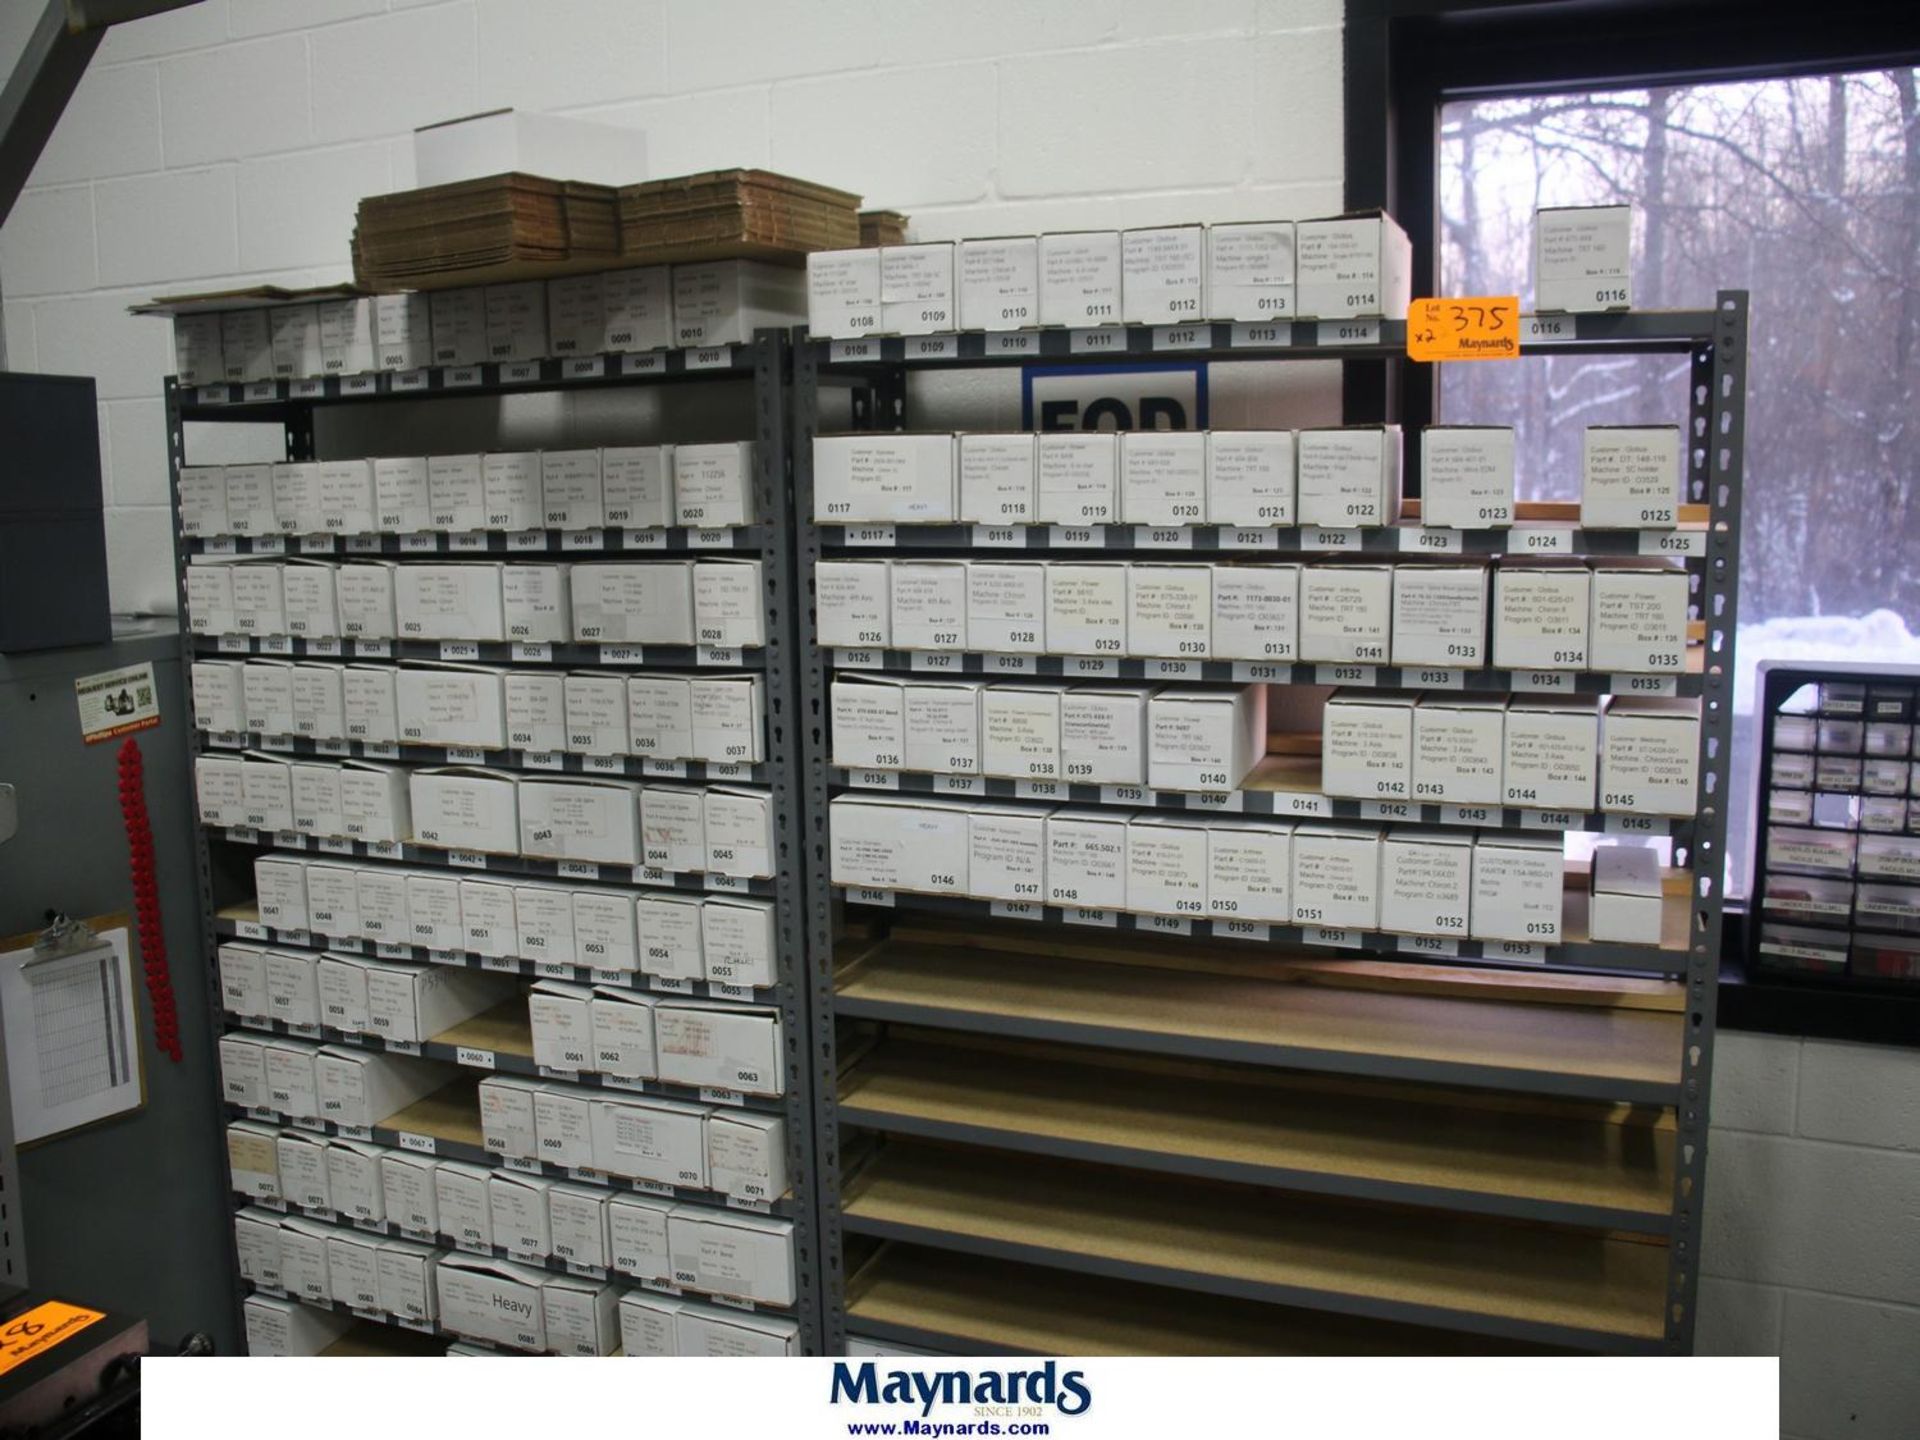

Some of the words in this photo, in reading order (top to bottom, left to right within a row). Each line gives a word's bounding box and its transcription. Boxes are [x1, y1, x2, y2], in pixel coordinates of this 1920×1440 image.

[1347, 294, 1374, 305] 0114
[1596, 290, 1625, 302] 0116
[1170, 300, 1195, 311] 0112
[1259, 299, 1285, 309] 0113
[1002, 307, 1027, 318] 0110
[1087, 305, 1111, 316] 0111
[922, 311, 945, 321] 0109
[1450, 306, 1508, 331] 375
[851, 317, 874, 327] 0108
[681, 328, 702, 338] 0010
[1340, 327, 1367, 338] 0114
[1532, 323, 1560, 334] 0116
[612, 334, 631, 344] 0009
[1087, 335, 1111, 345] 0111
[1169, 332, 1194, 343] 0112
[1250, 330, 1276, 341] 0113
[921, 342, 944, 353] 0109
[1002, 337, 1026, 348] 0110
[1459, 337, 1514, 352] Maynards
[699, 352, 719, 362] 0010
[828, 503, 850, 513] 0117
[1002, 504, 1025, 514] 0118
[1082, 506, 1106, 516] 0119
[1172, 506, 1198, 516] 0120
[1259, 507, 1284, 517] 0121
[1347, 505, 1374, 515] 0122
[548, 512, 566, 521] 0018
[609, 511, 628, 520] 0019
[683, 509, 703, 518] 0020
[1479, 508, 1507, 519] 0123
[1641, 510, 1670, 521] 0125
[491, 515, 508, 524] 0017
[861, 531, 883, 541] 0117
[989, 531, 1012, 541] 0118
[1066, 531, 1089, 541] 0119
[1153, 532, 1179, 542] 0120
[1238, 533, 1263, 544] 0121
[1319, 534, 1345, 544] 0122
[1420, 535, 1447, 547] 0123
[1528, 536, 1556, 547] 0124
[1661, 539, 1689, 550] 0125
[405, 622, 421, 631] 0025
[512, 626, 529, 635] 0026
[582, 628, 600, 636] 0027
[702, 630, 721, 639] 0028
[859, 632, 881, 642] 0126
[1011, 632, 1034, 642] 0128
[934, 634, 957, 644] 0127
[1096, 639, 1120, 650] 0129
[1180, 642, 1205, 653] 0130
[1265, 643, 1290, 654] 0131
[1356, 647, 1382, 658] 0141
[1449, 645, 1475, 657] 0133
[848, 653, 870, 662] 0126
[928, 656, 950, 666] 0127
[1554, 651, 1583, 662] 0134
[1649, 655, 1677, 665] 0135
[1000, 658, 1023, 668] 0128
[1080, 660, 1103, 670] 0129
[1161, 662, 1186, 673] 0130
[1251, 666, 1276, 677] 0131
[1335, 668, 1361, 679] 0132
[1421, 672, 1448, 683] 0133
[1533, 674, 1560, 686] 0134
[1632, 679, 1660, 690] 0135
[513, 733, 531, 742] 0034
[572, 736, 591, 745] 0035
[636, 738, 655, 747] 0036
[726, 746, 746, 755] 0037
[876, 754, 898, 765] 0136
[950, 758, 973, 768] 0137
[1030, 764, 1053, 774] 0138
[1068, 765, 1092, 775] 0139
[864, 774, 886, 784] 0136
[1200, 773, 1226, 784] 0140
[950, 779, 971, 789] 0137
[1032, 783, 1055, 793] 0138
[1377, 782, 1404, 793] 0142
[1417, 784, 1444, 794] 0143
[1117, 789, 1141, 799] 0139
[1509, 789, 1536, 800] 0144
[1605, 794, 1634, 805] 0145
[1293, 800, 1317, 811] 0141
[1380, 804, 1407, 816] 0142
[1459, 808, 1486, 820] 0143
[1541, 812, 1568, 825] 0144
[1623, 817, 1651, 829] 0145
[422, 831, 438, 840] 0042
[534, 831, 552, 840] 0043
[648, 850, 667, 860] 0044
[714, 850, 733, 860] 0045
[931, 874, 954, 885] 0146
[1015, 884, 1038, 894] 0147
[1053, 889, 1077, 899] 0148
[862, 890, 883, 900] 0146
[1007, 903, 1030, 913] 0147
[1177, 900, 1201, 911] 0149
[1212, 900, 1237, 911] 0150
[1079, 910, 1103, 920] 0148
[1297, 908, 1322, 919] 0151
[1154, 917, 1179, 928] 0149
[1229, 921, 1254, 932] 0150
[1436, 916, 1463, 928] 0152
[416, 926, 433, 934] 0050
[1527, 923, 1554, 934] 0153
[1320, 930, 1345, 941] 0151
[526, 936, 544, 946] 0052
[1415, 937, 1442, 949] 0152
[586, 944, 604, 953] 0053
[650, 948, 668, 958] 0054
[1504, 944, 1531, 954] 0153
[713, 966, 732, 976] 0055
[467, 1052, 483, 1061] 0060
[565, 1052, 583, 1062] 0061
[600, 1052, 619, 1062] 0062
[738, 1072, 758, 1081] 0063
[409, 1139, 425, 1148] 0067
[544, 1138, 562, 1148] 0069
[679, 1170, 697, 1180] 0070
[259, 1183, 274, 1192] 0072
[745, 1185, 764, 1196] 0071
[522, 1237, 537, 1247] 0077
[557, 1245, 573, 1255] 0078
[618, 1257, 637, 1267] 0079
[676, 1272, 695, 1282] 0080
[492, 1294, 532, 1318] Heavy
